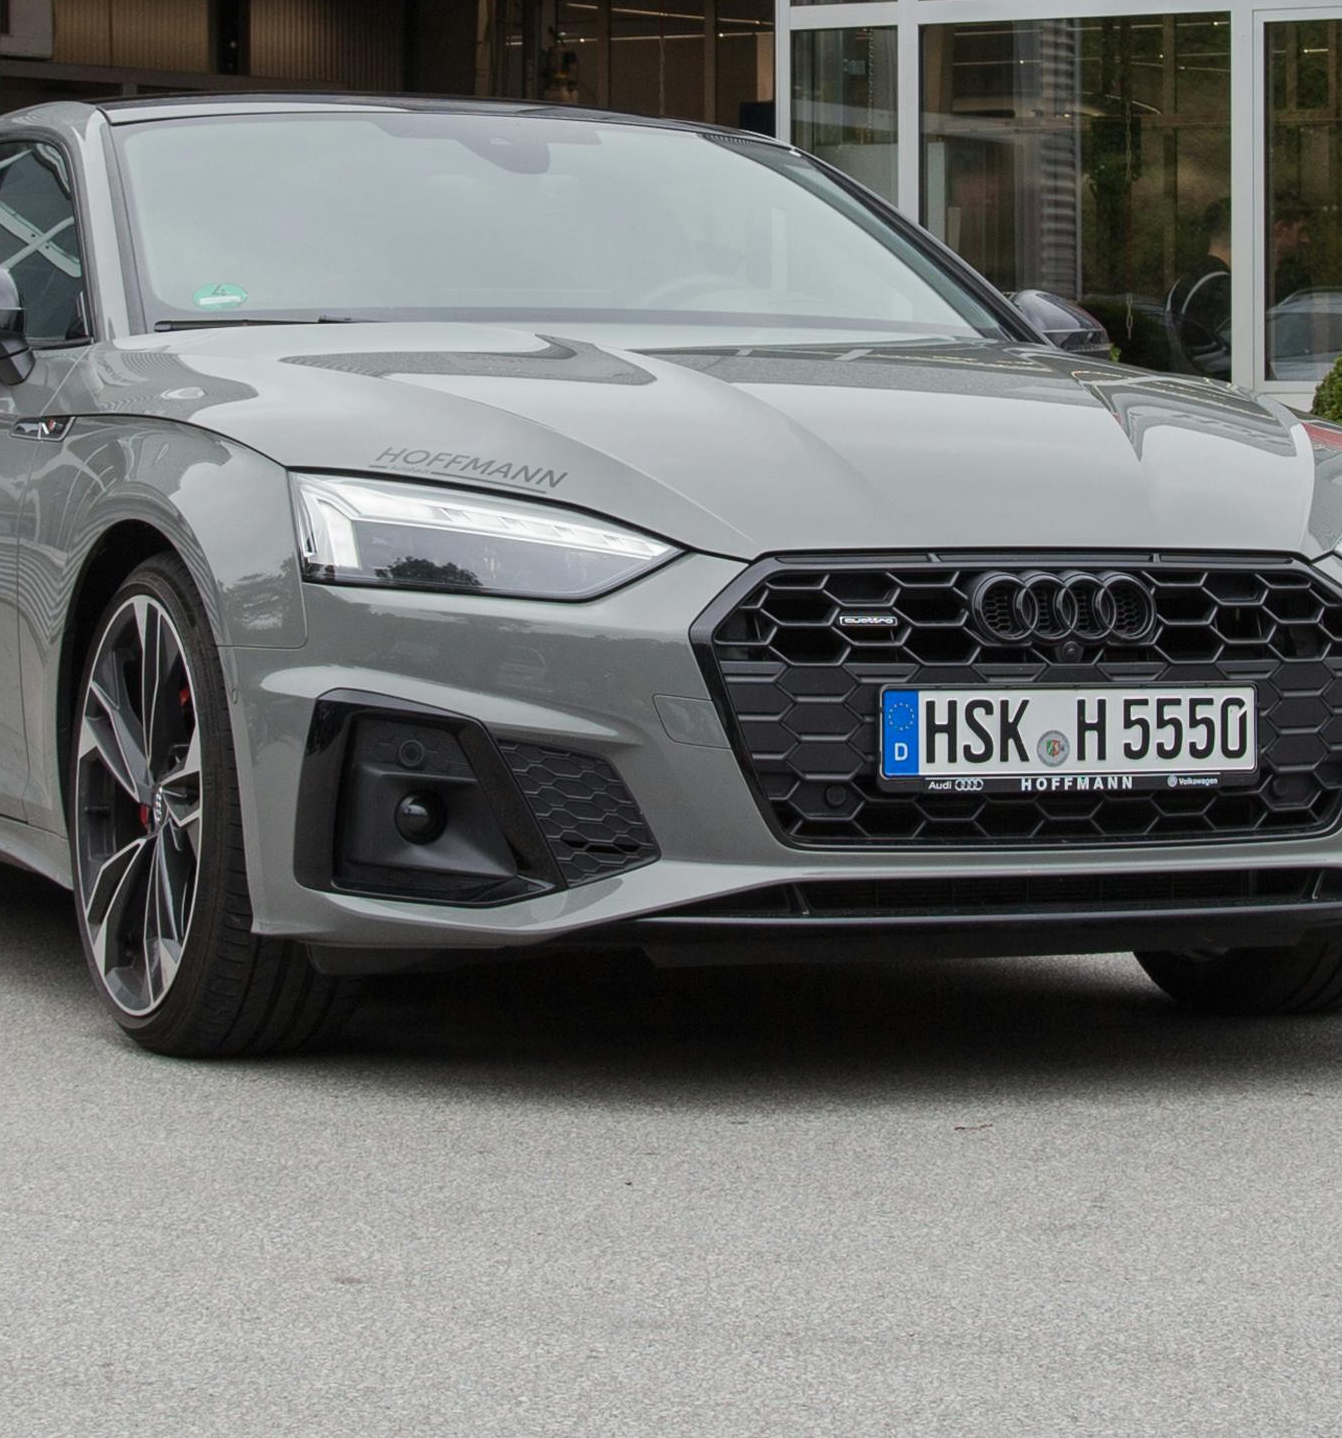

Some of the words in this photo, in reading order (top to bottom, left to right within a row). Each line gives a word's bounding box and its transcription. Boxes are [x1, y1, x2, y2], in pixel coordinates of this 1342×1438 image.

[374, 446, 569, 489] HOFFMANN
[924, 698, 1032, 764] HSK
[1076, 697, 1107, 762] H
[1122, 696, 1248, 760] 5550
[893, 742, 909, 762] D
[928, 779, 952, 790] Audi
[1020, 776, 1134, 791] HOFFMANN
[1178, 776, 1218, 788] Volkswagen
